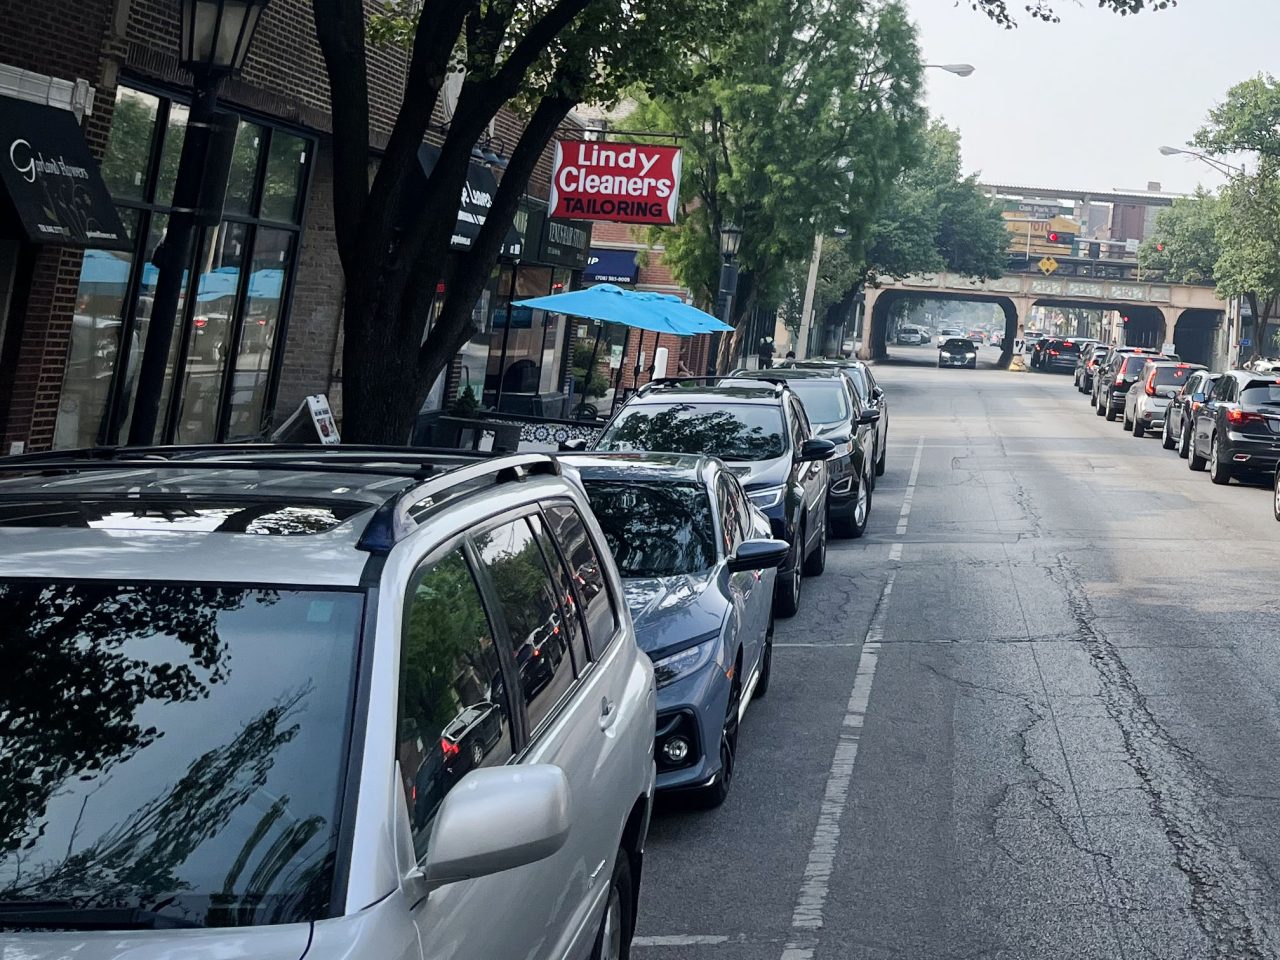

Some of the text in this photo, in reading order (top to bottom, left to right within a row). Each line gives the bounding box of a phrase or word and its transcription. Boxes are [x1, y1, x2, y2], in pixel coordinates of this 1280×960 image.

[578, 144, 660, 176] Lindy
[559, 166, 672, 198] Cleaners
[563, 197, 663, 217] TAILORING
[1033, 205, 1049, 213] Park
